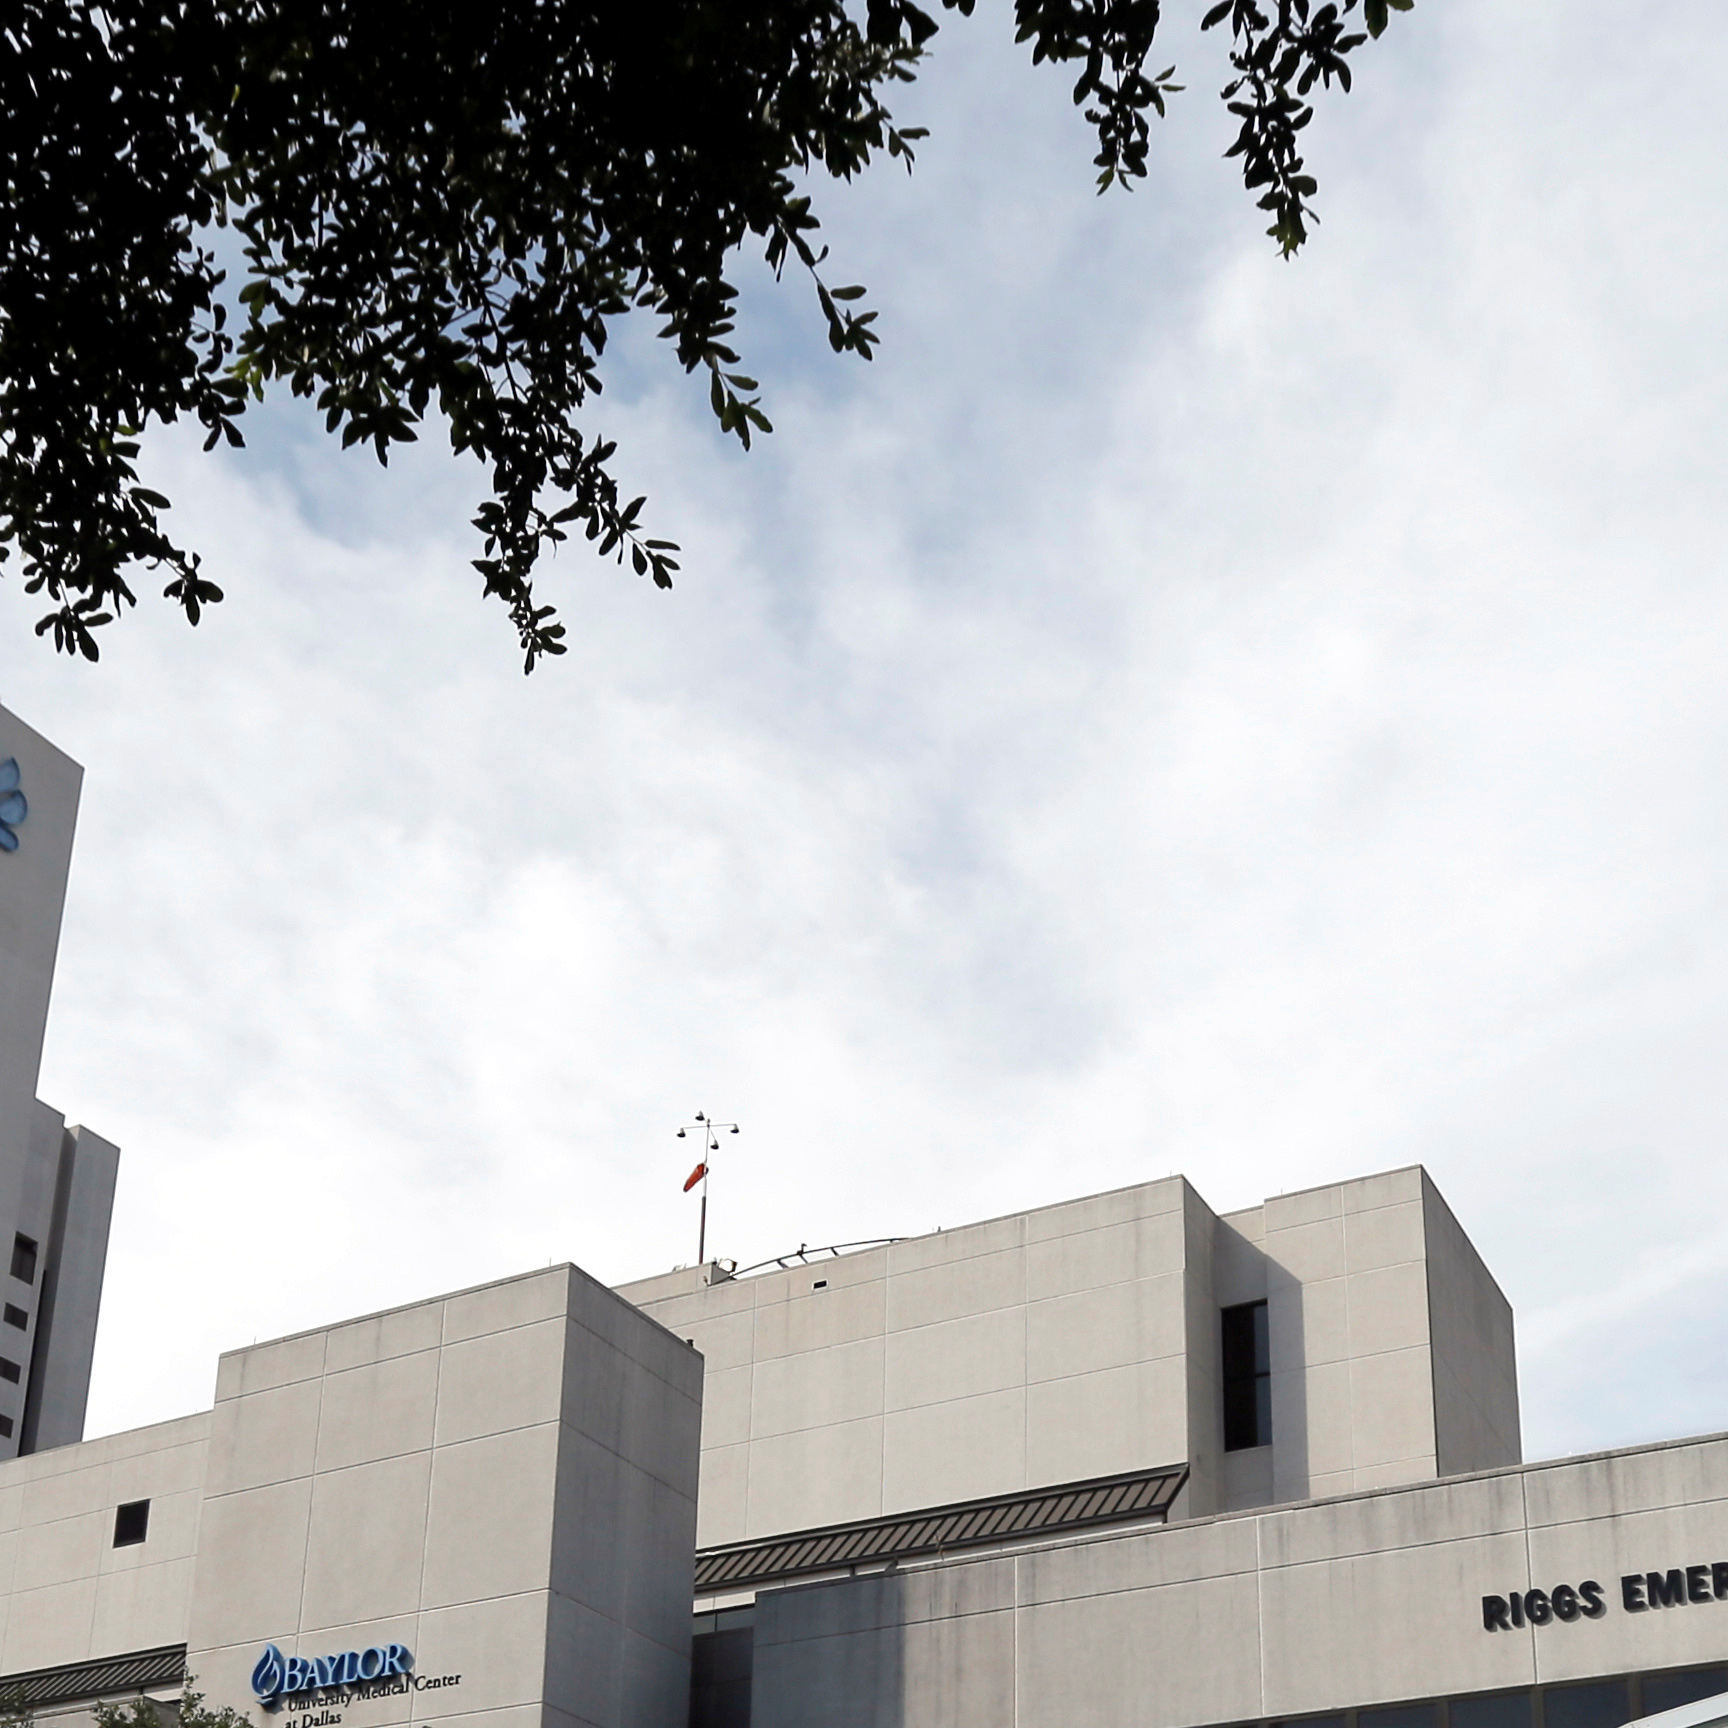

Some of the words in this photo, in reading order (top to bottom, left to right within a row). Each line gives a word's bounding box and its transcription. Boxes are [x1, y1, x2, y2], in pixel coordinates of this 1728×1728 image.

[1482, 1579, 1605, 1631] RIGGS
[281, 1643, 414, 1694] BAYLOR
[288, 1690, 354, 1713] University
[357, 1675, 410, 1702] Medical
[414, 1673, 462, 1692] Center
[301, 1709, 343, 1728] Dallas
